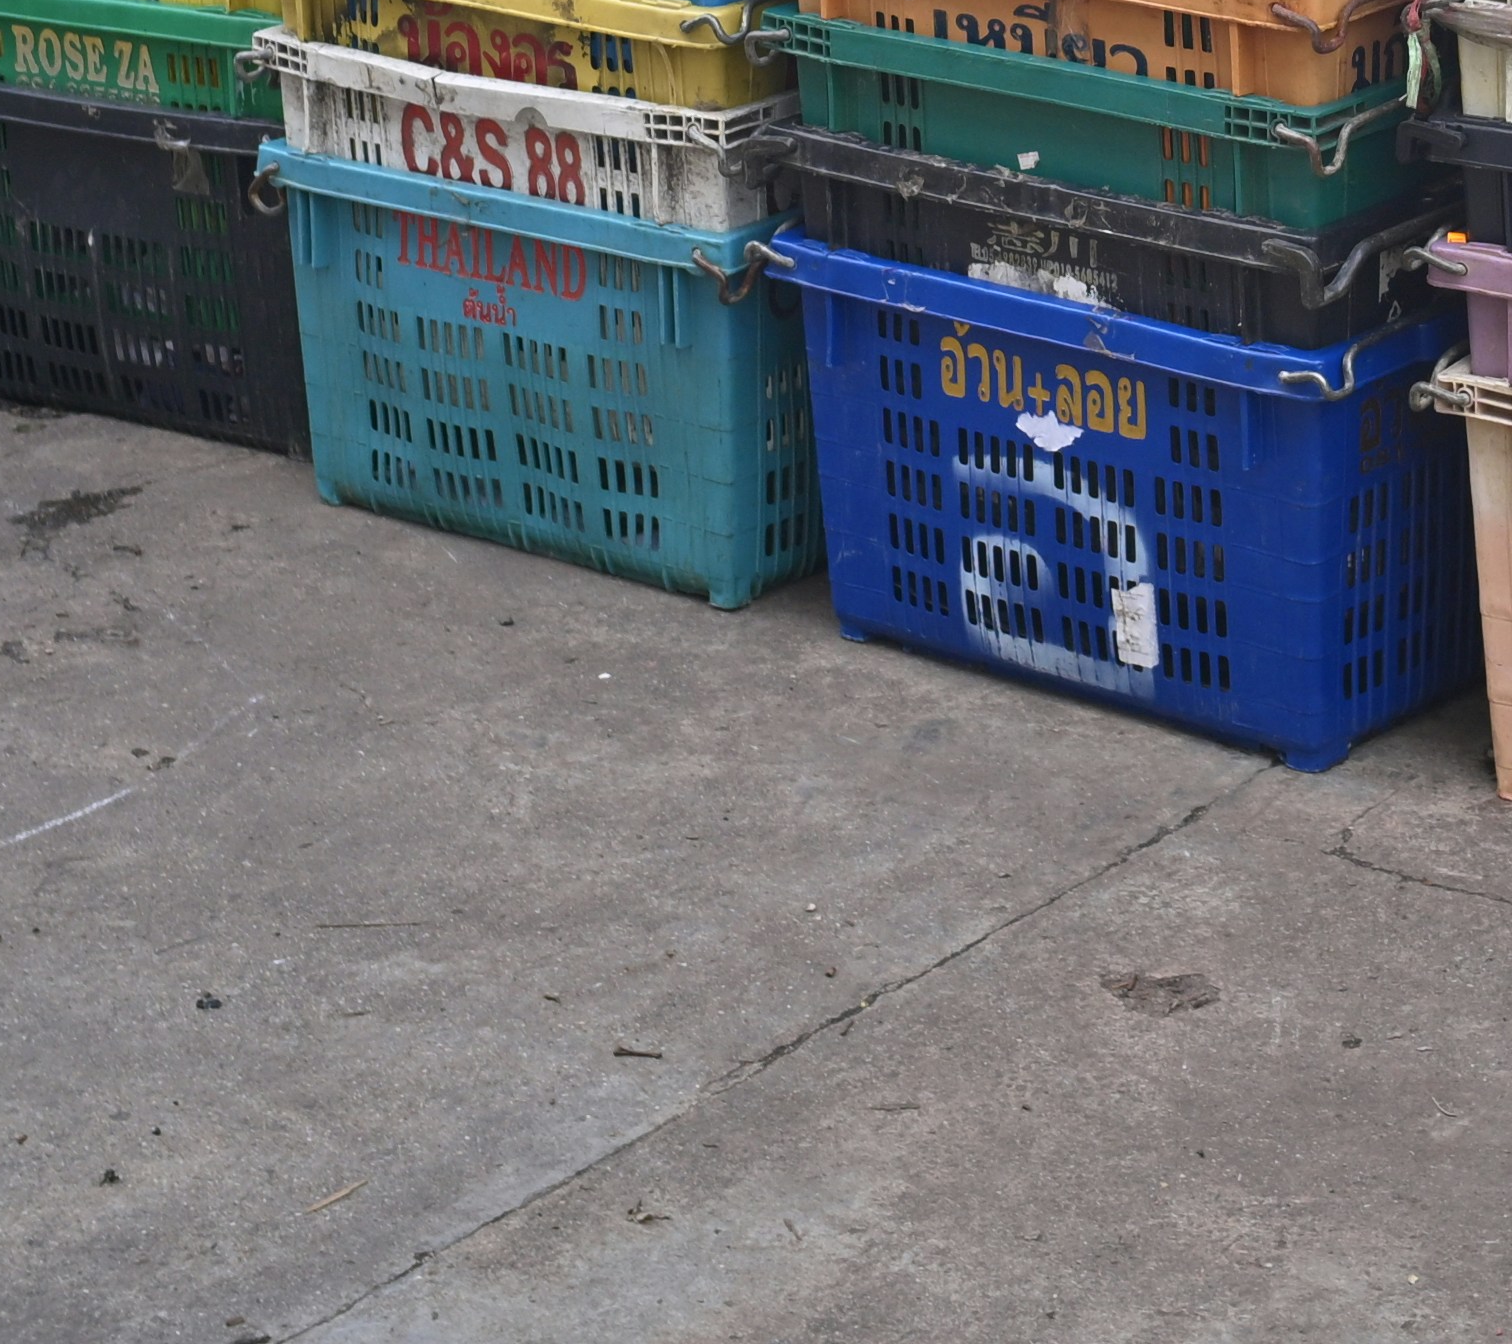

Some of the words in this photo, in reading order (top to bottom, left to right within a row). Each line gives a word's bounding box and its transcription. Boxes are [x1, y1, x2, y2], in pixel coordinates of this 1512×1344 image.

[12, 24, 108, 83] ROSE
[114, 39, 160, 94] ZA
[401, 102, 513, 191] C&S
[525, 126, 586, 206] 88
[392, 208, 587, 303] THAILAND
